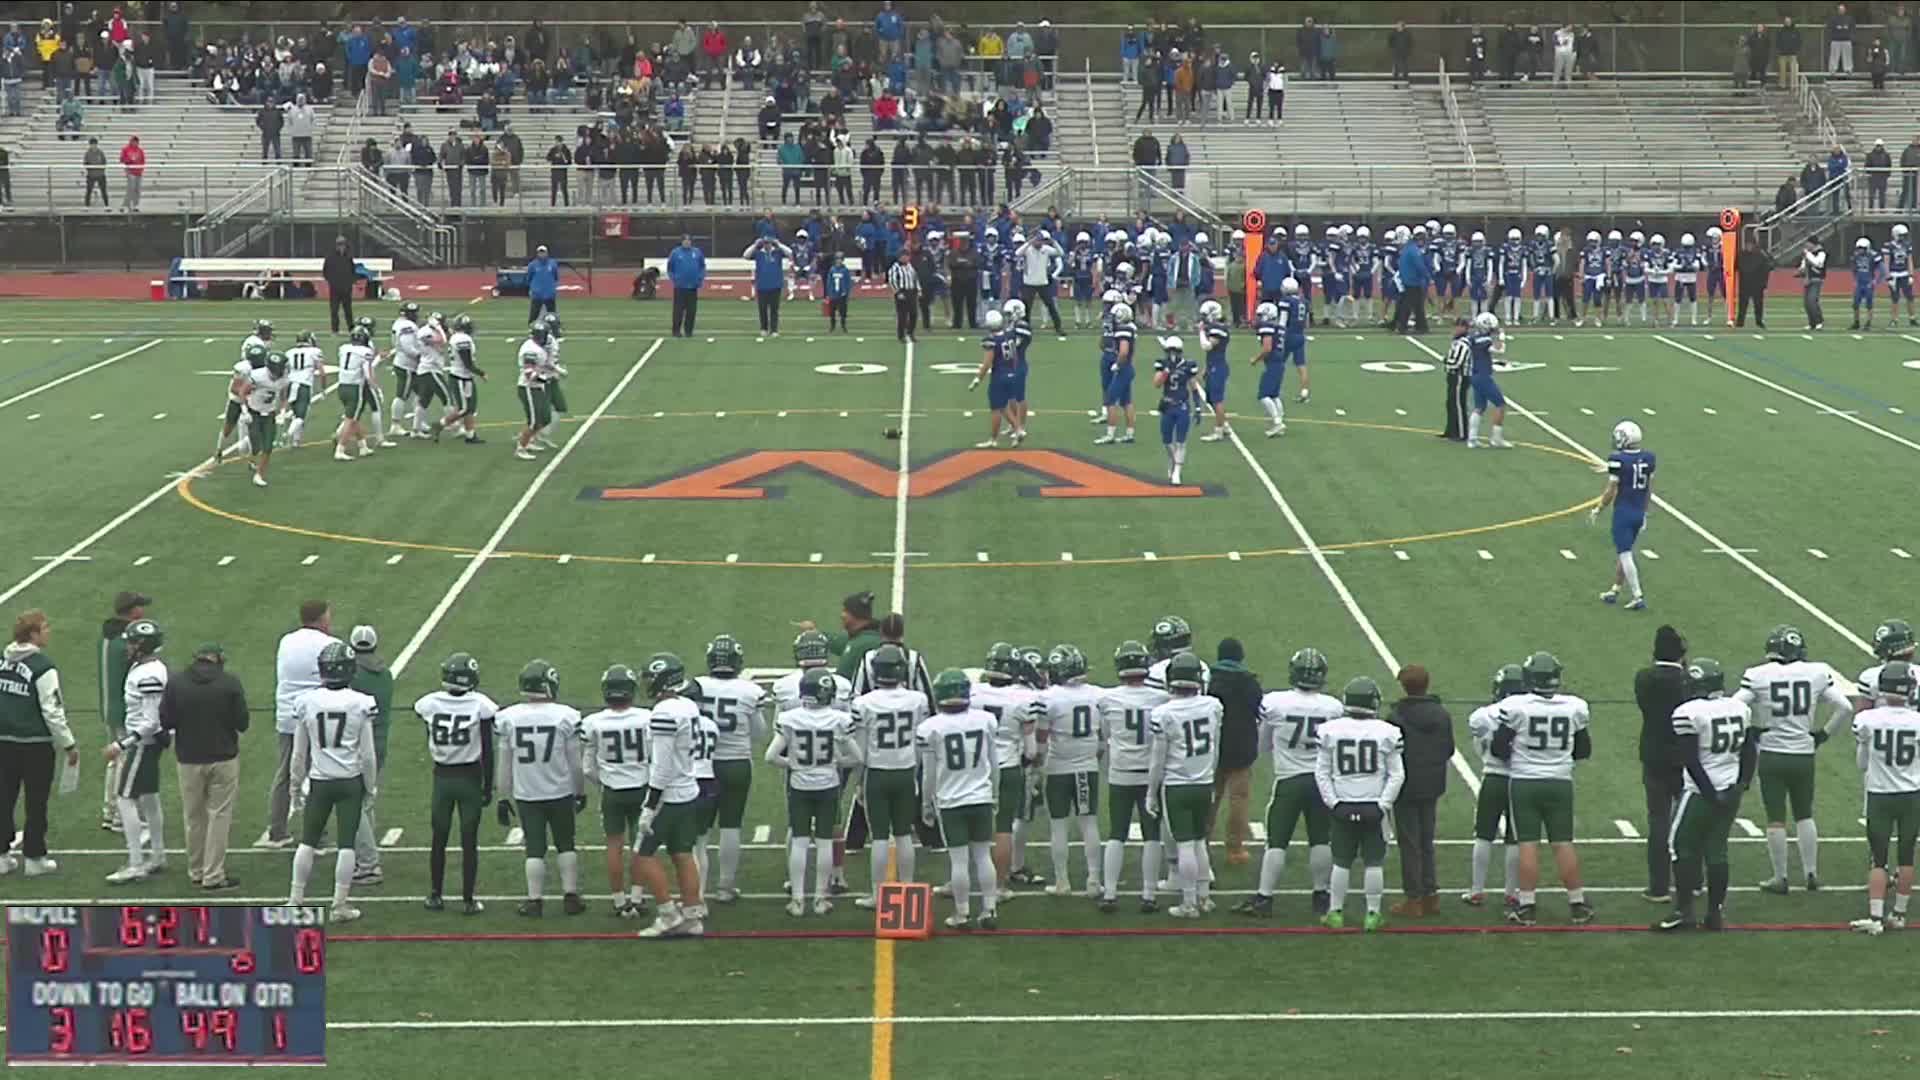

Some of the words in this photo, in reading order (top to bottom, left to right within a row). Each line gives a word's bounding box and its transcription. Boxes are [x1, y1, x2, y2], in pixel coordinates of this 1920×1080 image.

[904, 207, 918, 230] 3
[294, 353, 305, 370] 11
[343, 352, 351, 370] 1
[1632, 463, 1649, 489] 15
[1771, 681, 1811, 717] 50
[316, 712, 348, 749] 17
[432, 713, 471, 745] 66
[876, 711, 914, 749] 22
[1072, 706, 1091, 737] 0
[1125, 709, 1145, 745] 4
[1182, 717, 1211, 758] 15
[1528, 716, 1570, 750] 59
[515, 726, 556, 764] 57
[602, 728, 644, 763] 34
[795, 730, 834, 766] 33
[944, 729, 984, 771] 87
[1336, 739, 1378, 775] 60
[1873, 729, 1916, 767] 46
[881, 886, 926, 929] 50
